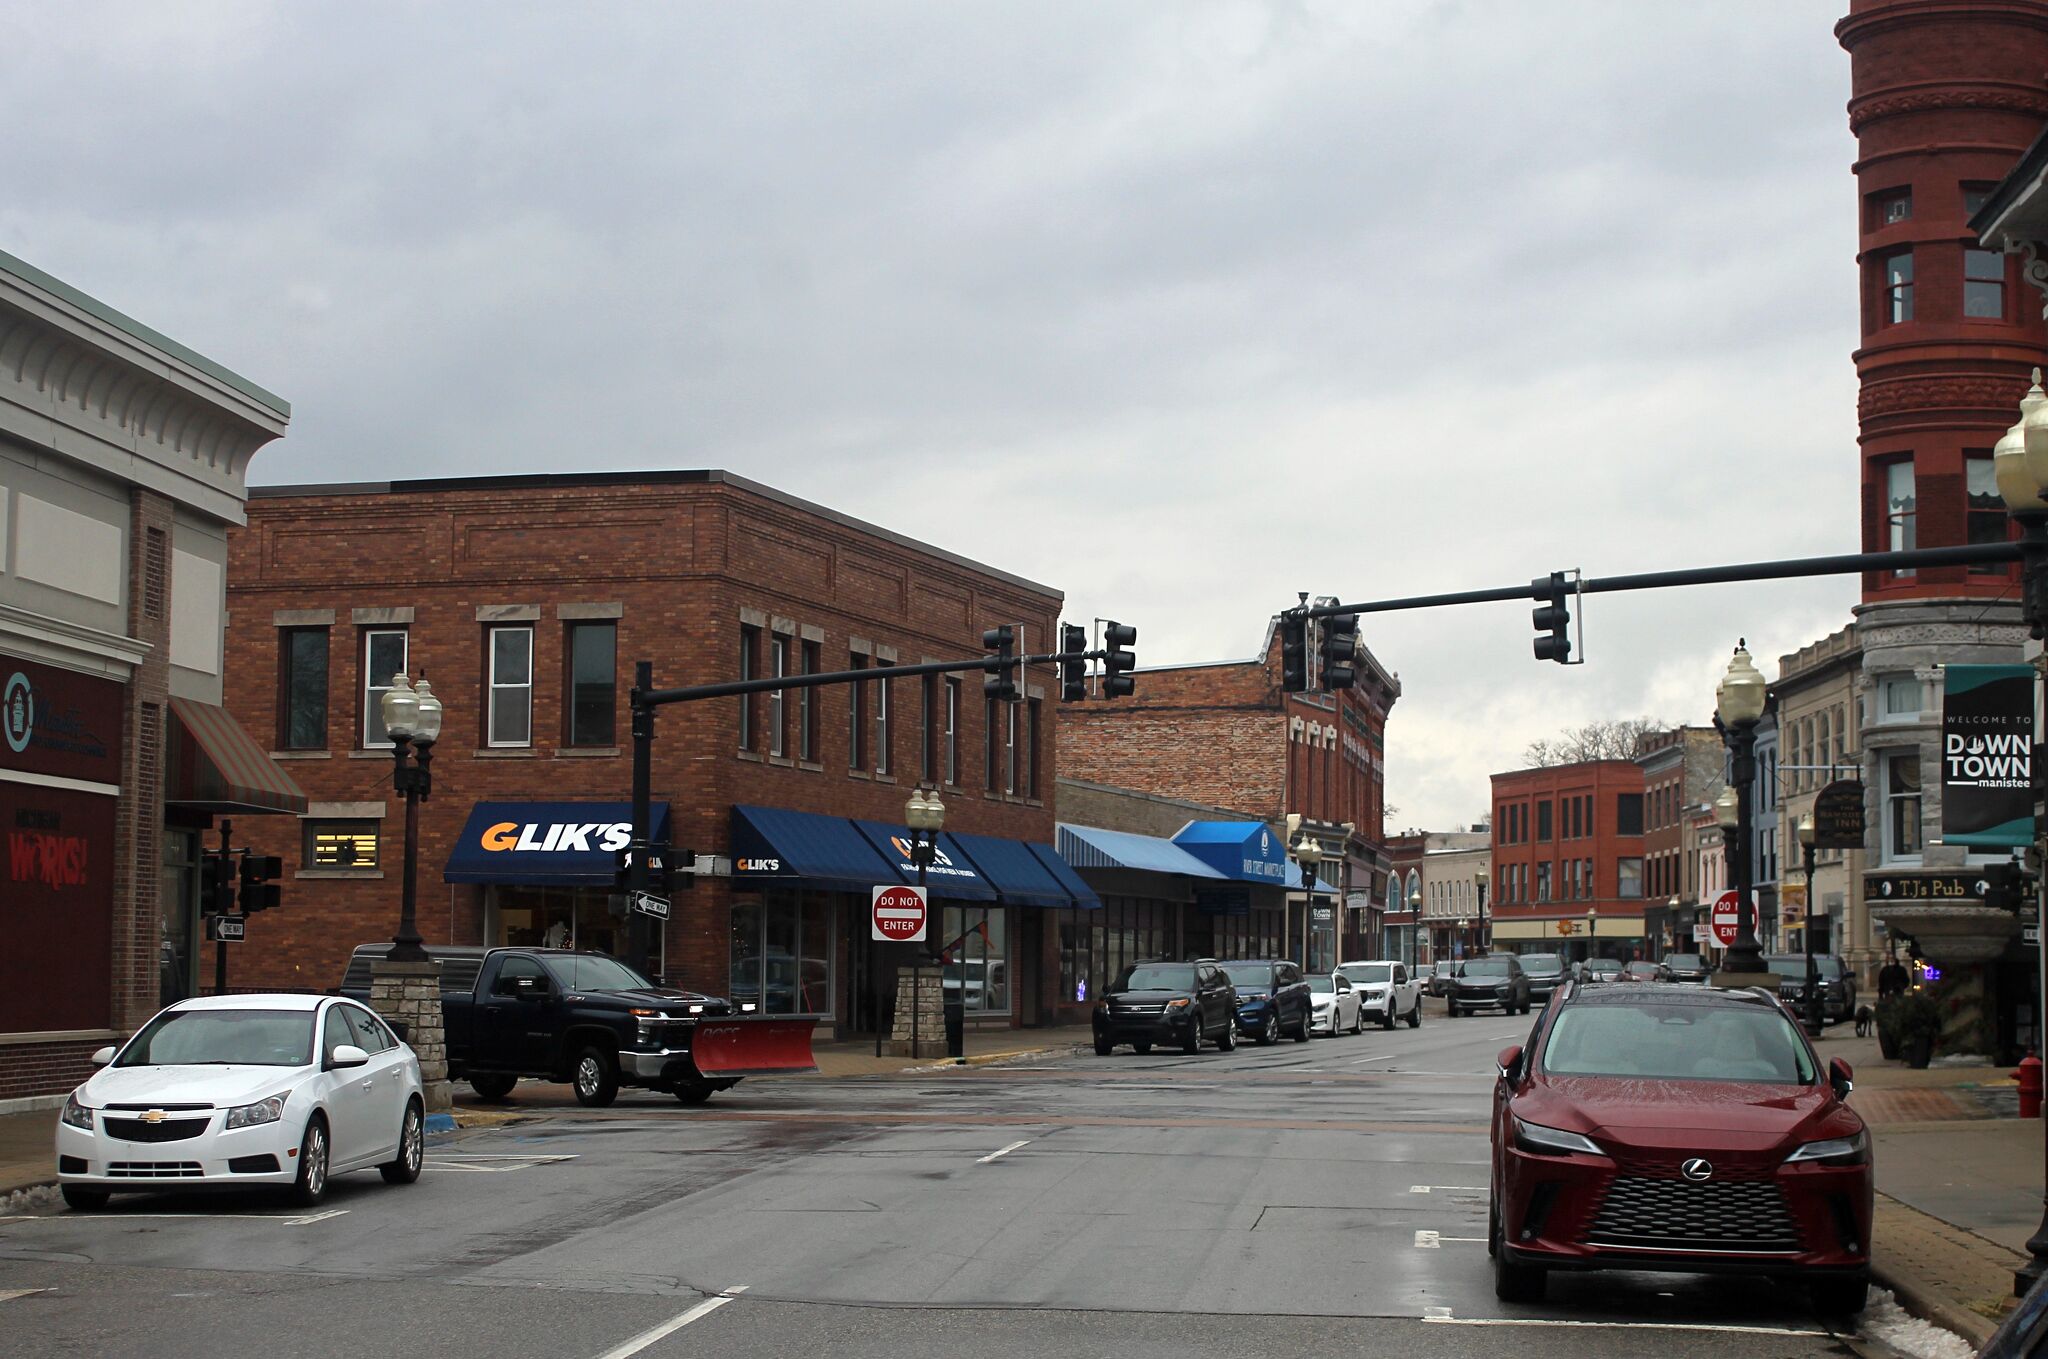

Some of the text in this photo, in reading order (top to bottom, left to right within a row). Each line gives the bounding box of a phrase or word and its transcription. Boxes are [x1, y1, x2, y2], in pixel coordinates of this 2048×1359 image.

[1947, 716, 2031, 724] WELCOME TO
[1946, 733, 2031, 755] DOWN
[1946, 755, 2031, 777] TOWN
[1978, 777, 2031, 788] manistee
[1835, 819, 1861, 828] INN
[480, 822, 633, 852] GLIK'S
[737, 858, 780, 871] GLIK'S
[1932, 879, 1965, 896] Pub
[645, 900, 666, 913] ONE WAY
[881, 896, 919, 906] DO NOT
[1718, 901, 1731, 911] DO
[224, 924, 242, 934] ONE WAY
[883, 920, 915, 931] ENTER
[1721, 927, 1738, 937] ENT
